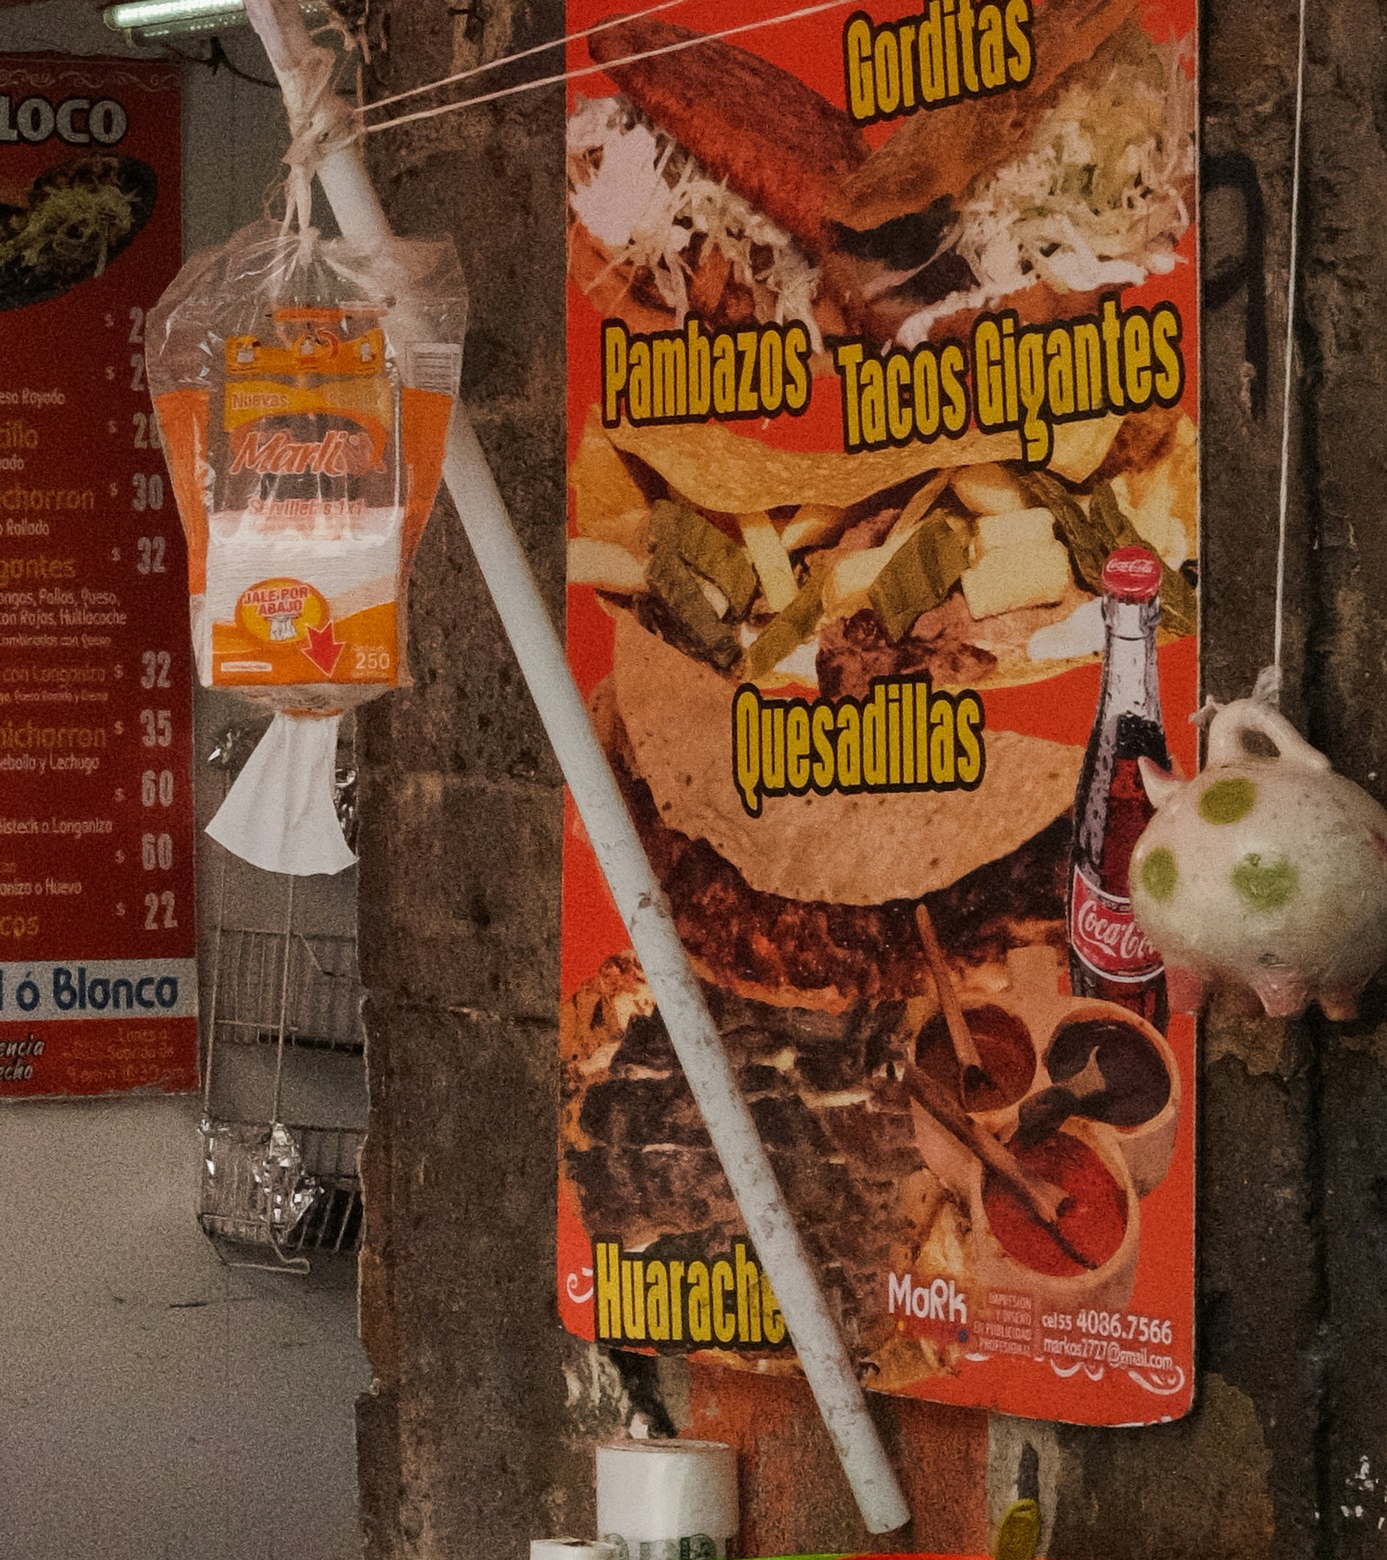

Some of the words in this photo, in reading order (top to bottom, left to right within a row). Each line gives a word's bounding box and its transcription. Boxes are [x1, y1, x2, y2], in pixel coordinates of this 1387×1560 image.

[604, 321, 809, 421] Pambazos
[837, 343, 966, 446] Tacos
[975, 300, 1181, 461] Gigantes
[230, 391, 290, 410] Nuevas
[132, 472, 164, 512] 30
[137, 536, 167, 575] 32
[243, 587, 281, 605] JALE
[282, 584, 309, 600] POR
[257, 599, 303, 616] ABAJO
[141, 650, 172, 689] 32
[355, 652, 391, 670] 250
[139, 709, 172, 747] 35
[736, 681, 982, 811] Quesadillas
[141, 769, 174, 807] 60
[141, 832, 173, 870] 60
[144, 890, 178, 930] 22
[15, 971, 40, 1012] ó
[52, 966, 179, 1012] Blanco
[1075, 1308, 1173, 1345] 4086.7566
